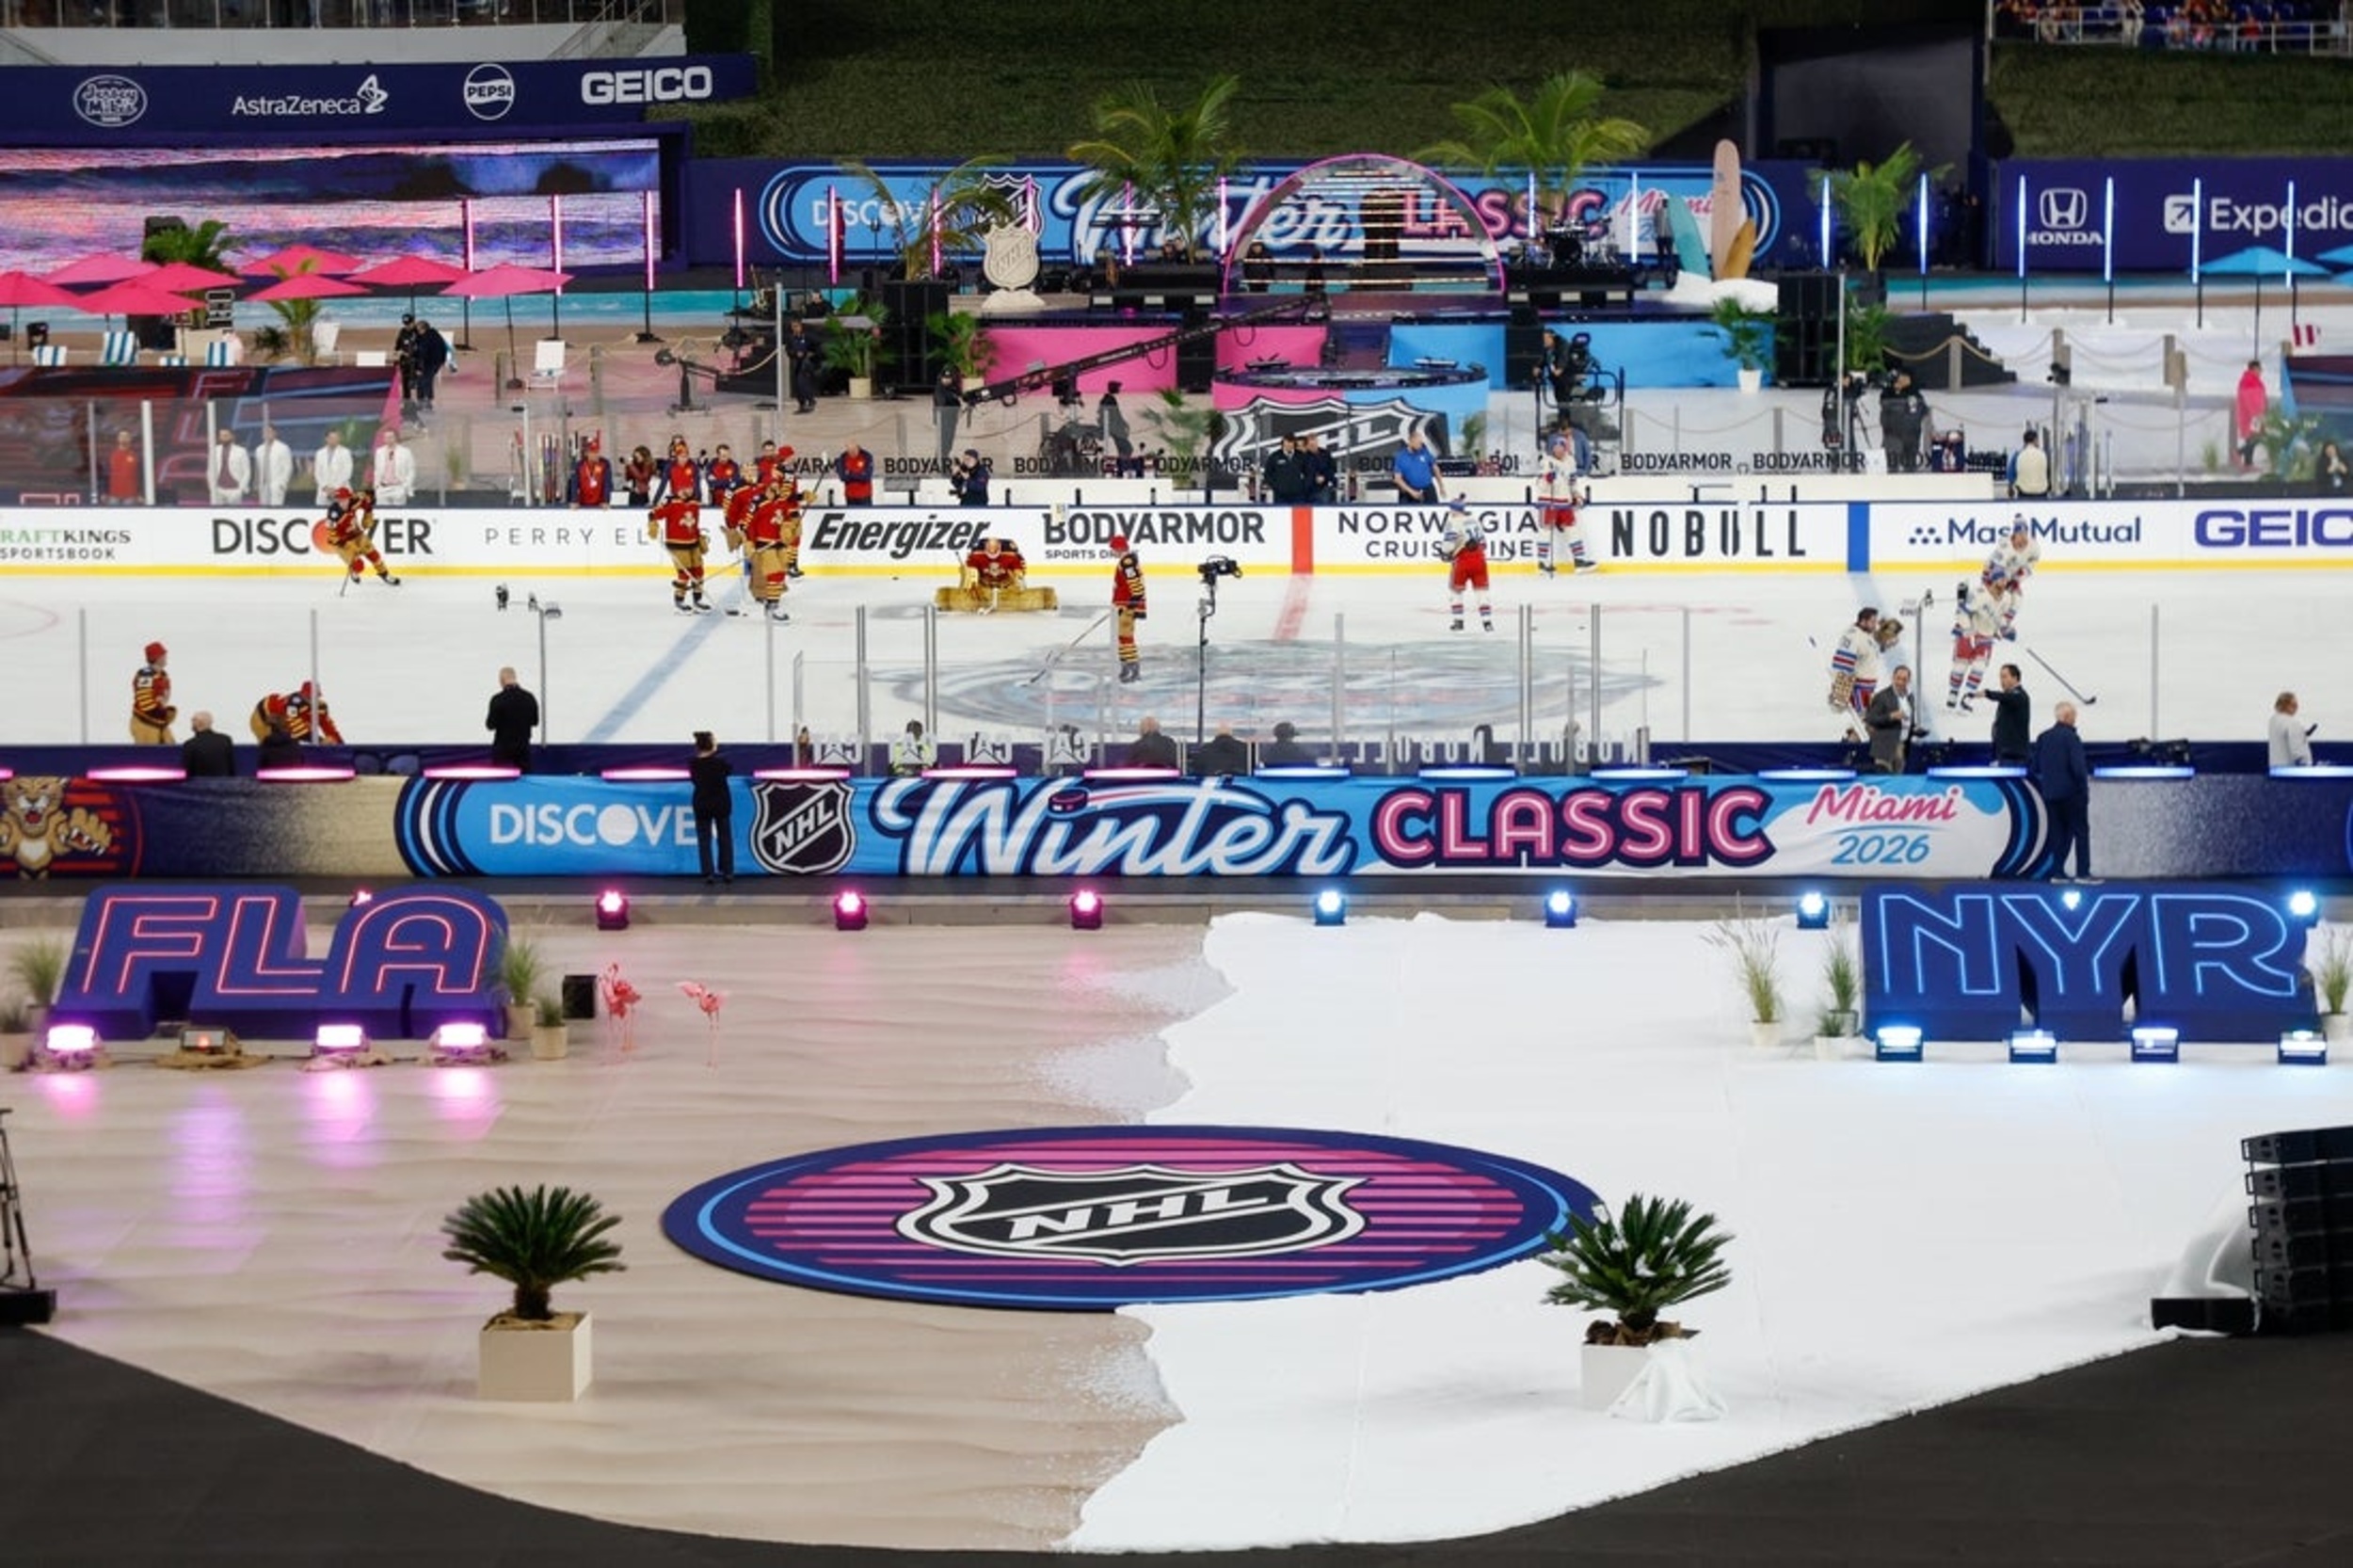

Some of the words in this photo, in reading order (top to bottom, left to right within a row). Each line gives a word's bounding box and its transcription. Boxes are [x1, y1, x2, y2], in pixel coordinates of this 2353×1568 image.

[468, 85, 512, 98] PEPSI
[580, 66, 713, 105] GEICO
[232, 94, 360, 116] AstraZeneca
[883, 456, 994, 473] BODYARR
[1620, 453, 1733, 471] BODYARMOR
[486, 528, 594, 546] PERRY
[809, 512, 991, 559] Energizer
[1042, 511, 1266, 545] BODYARMOR
[1337, 510, 1540, 534] NORWGIA
[1611, 510, 1806, 557] NOBULL
[1947, 516, 2141, 545] MasMutual
[2195, 509, 2353, 548] GEIC
[1045, 549, 1096, 560] SPORTS
[1366, 539, 1444, 558] CRUIS
[1490, 539, 1533, 557] INE
[1805, 784, 1962, 825] Miami
[488, 803, 700, 846] DISCOVE
[774, 799, 835, 856] NHL
[872, 776, 1361, 875] Winter
[1373, 787, 1774, 864] CLASSIC
[1831, 834, 1929, 865] 2026
[82, 896, 490, 996] FLA
[1880, 893, 2297, 996] NYR
[1008, 1188, 1270, 1240] NHL
